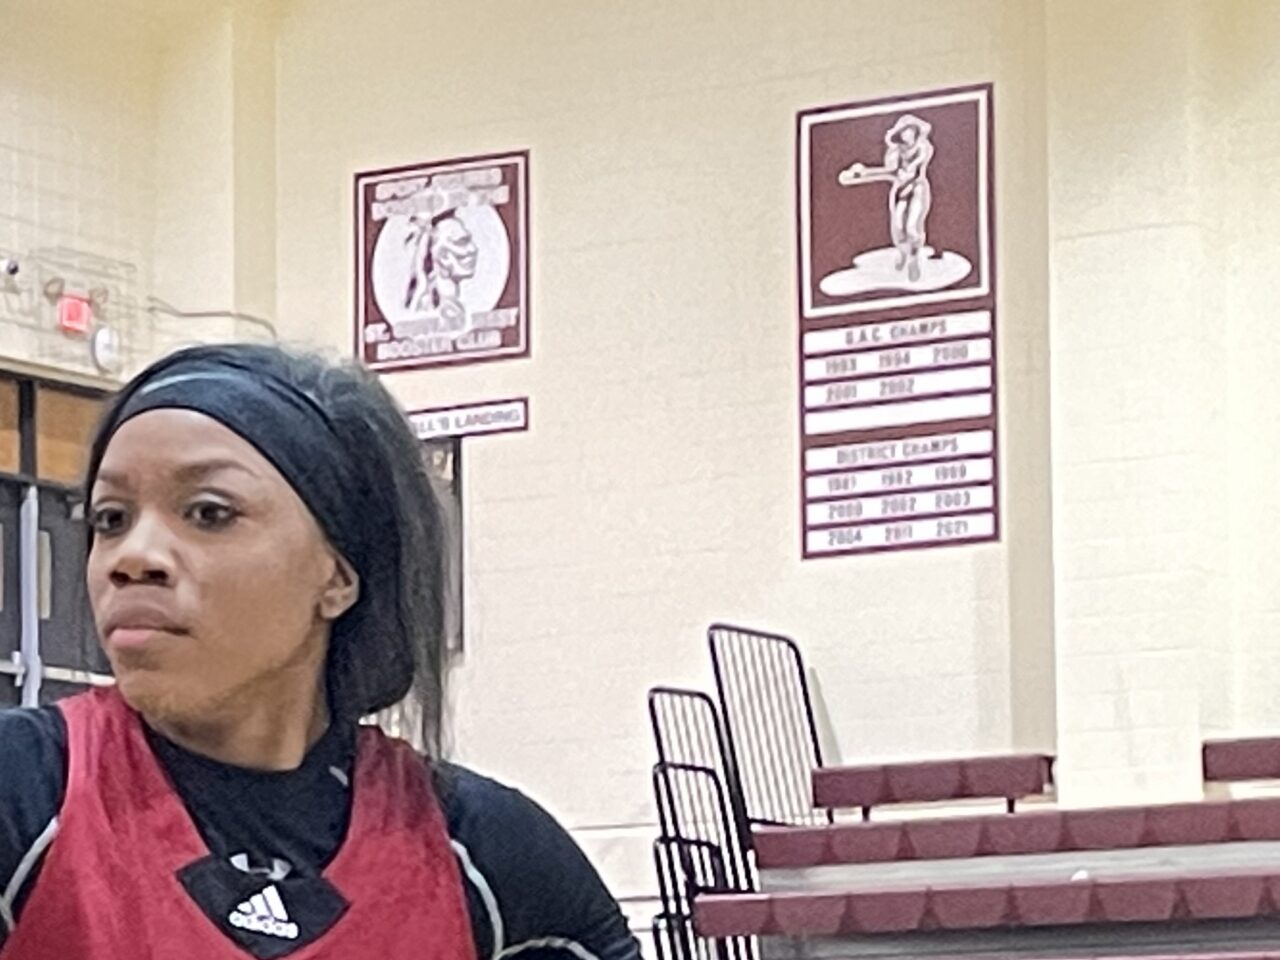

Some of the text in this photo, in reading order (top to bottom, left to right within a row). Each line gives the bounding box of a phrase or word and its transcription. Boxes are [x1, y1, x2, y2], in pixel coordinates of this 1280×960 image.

[891, 320, 947, 340] CHAMPS
[837, 438, 958, 464] DISTRICT CHAMPS
